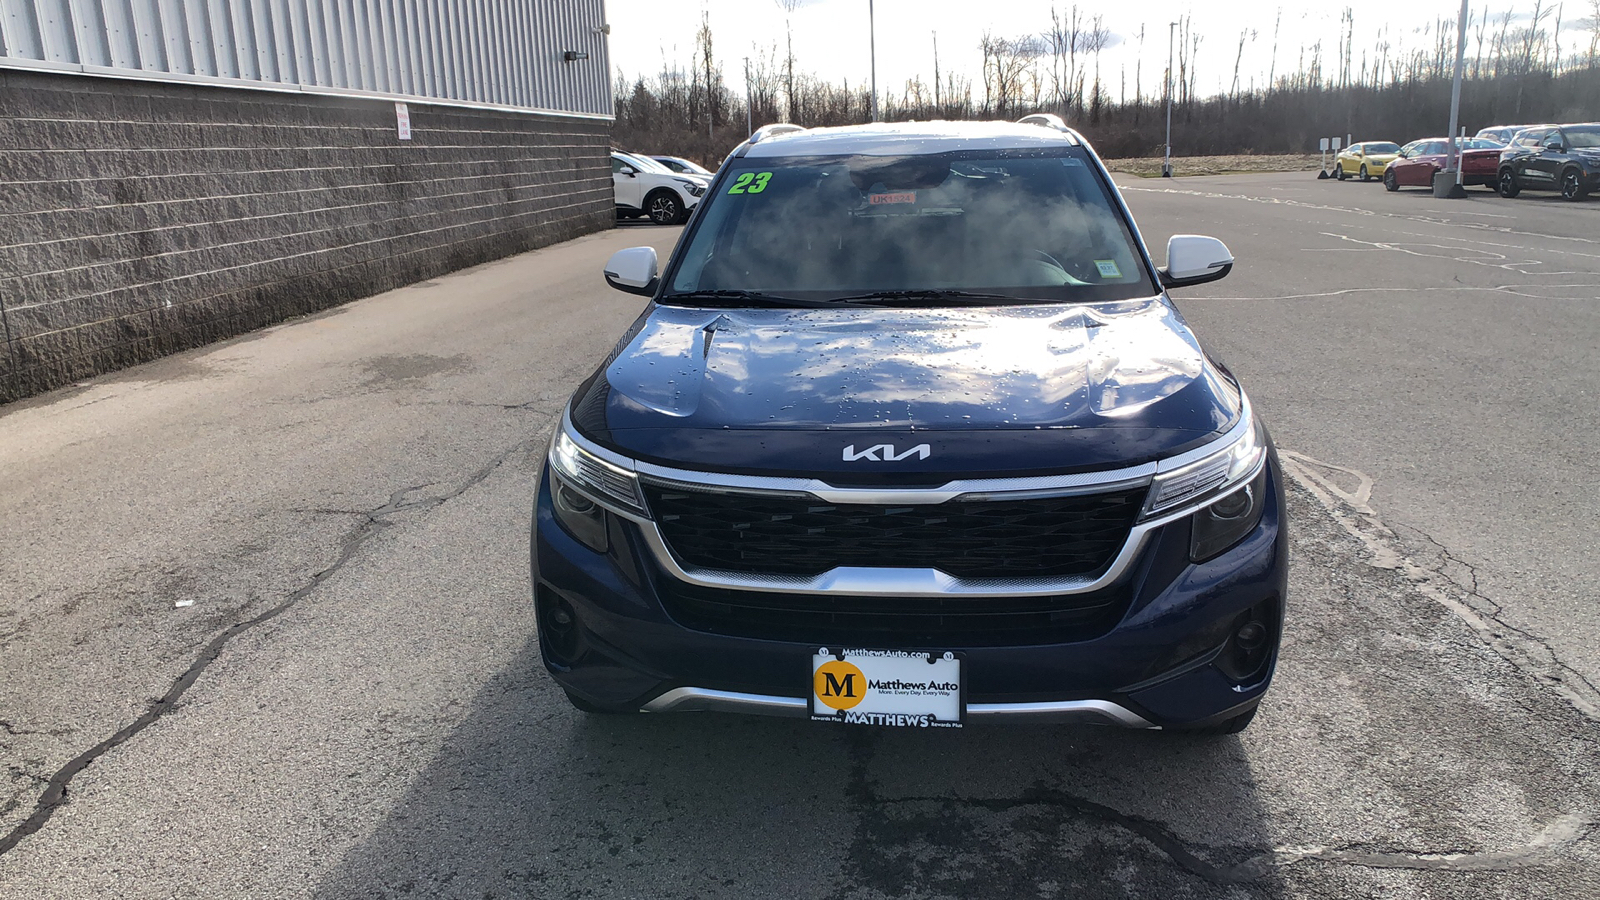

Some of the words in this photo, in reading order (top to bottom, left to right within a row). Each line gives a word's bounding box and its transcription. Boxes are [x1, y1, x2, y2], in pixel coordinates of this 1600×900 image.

[727, 172, 773, 194] 23
[873, 195, 911, 204] UK1524
[842, 444, 931, 461] KIA
[842, 649, 931, 660] MatthewsAuto.com
[822, 672, 857, 698] M
[868, 679, 926, 690] Matthews
[927, 680, 958, 691] Auto
[844, 712, 929, 728] MATTHEWS
